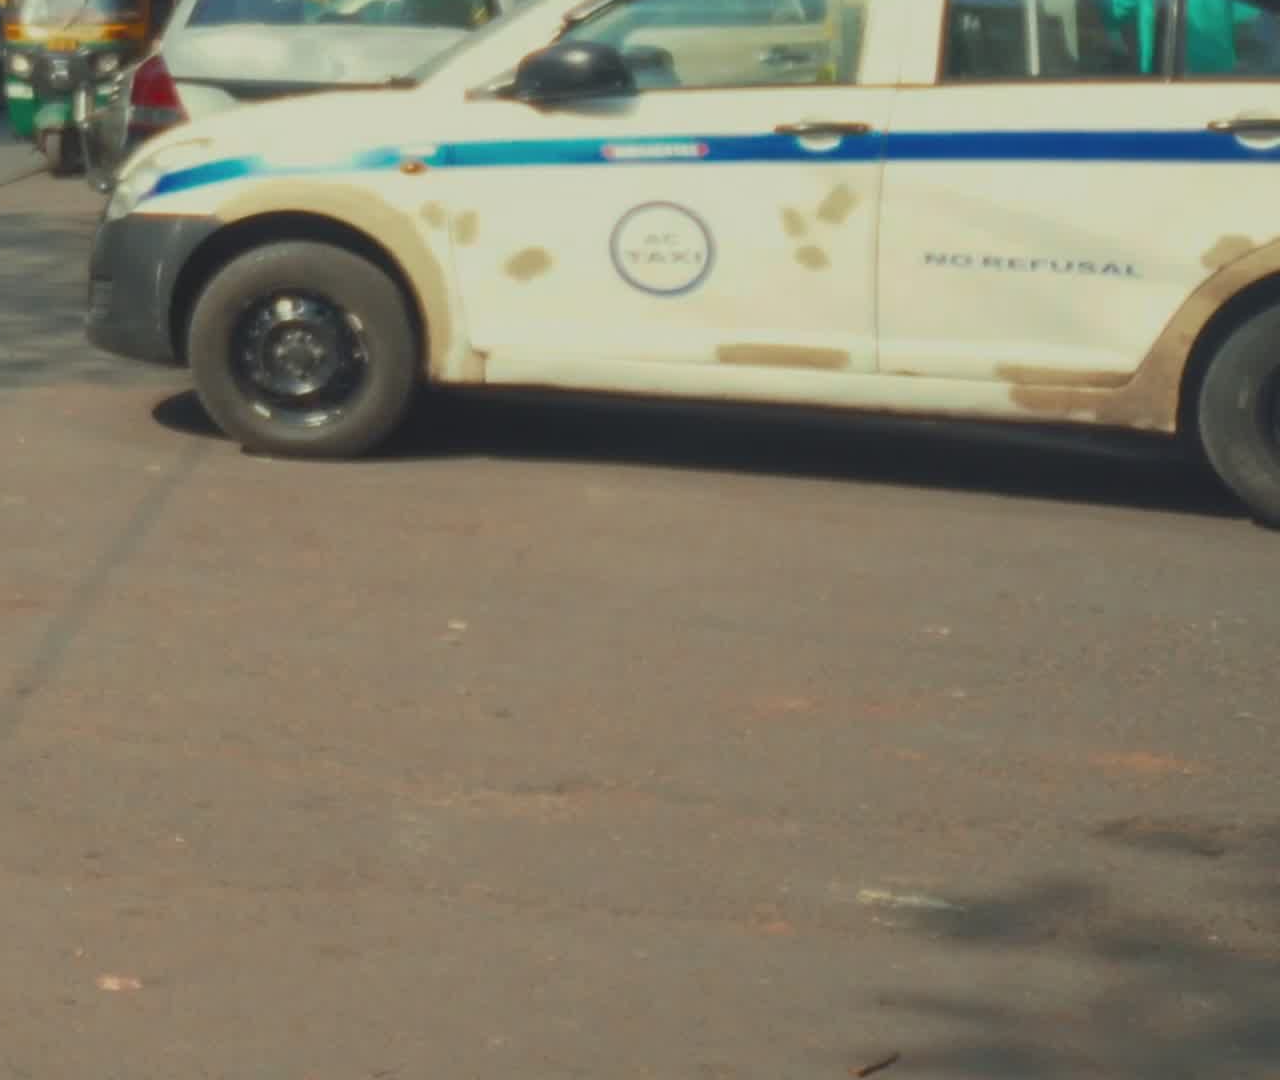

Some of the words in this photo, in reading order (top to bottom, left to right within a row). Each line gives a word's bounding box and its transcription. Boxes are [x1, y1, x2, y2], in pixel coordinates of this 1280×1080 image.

[644, 233, 681, 246] AC
[625, 250, 702, 264] TAXI
[924, 251, 973, 267] NO
[982, 254, 1143, 279] REFUSAL
